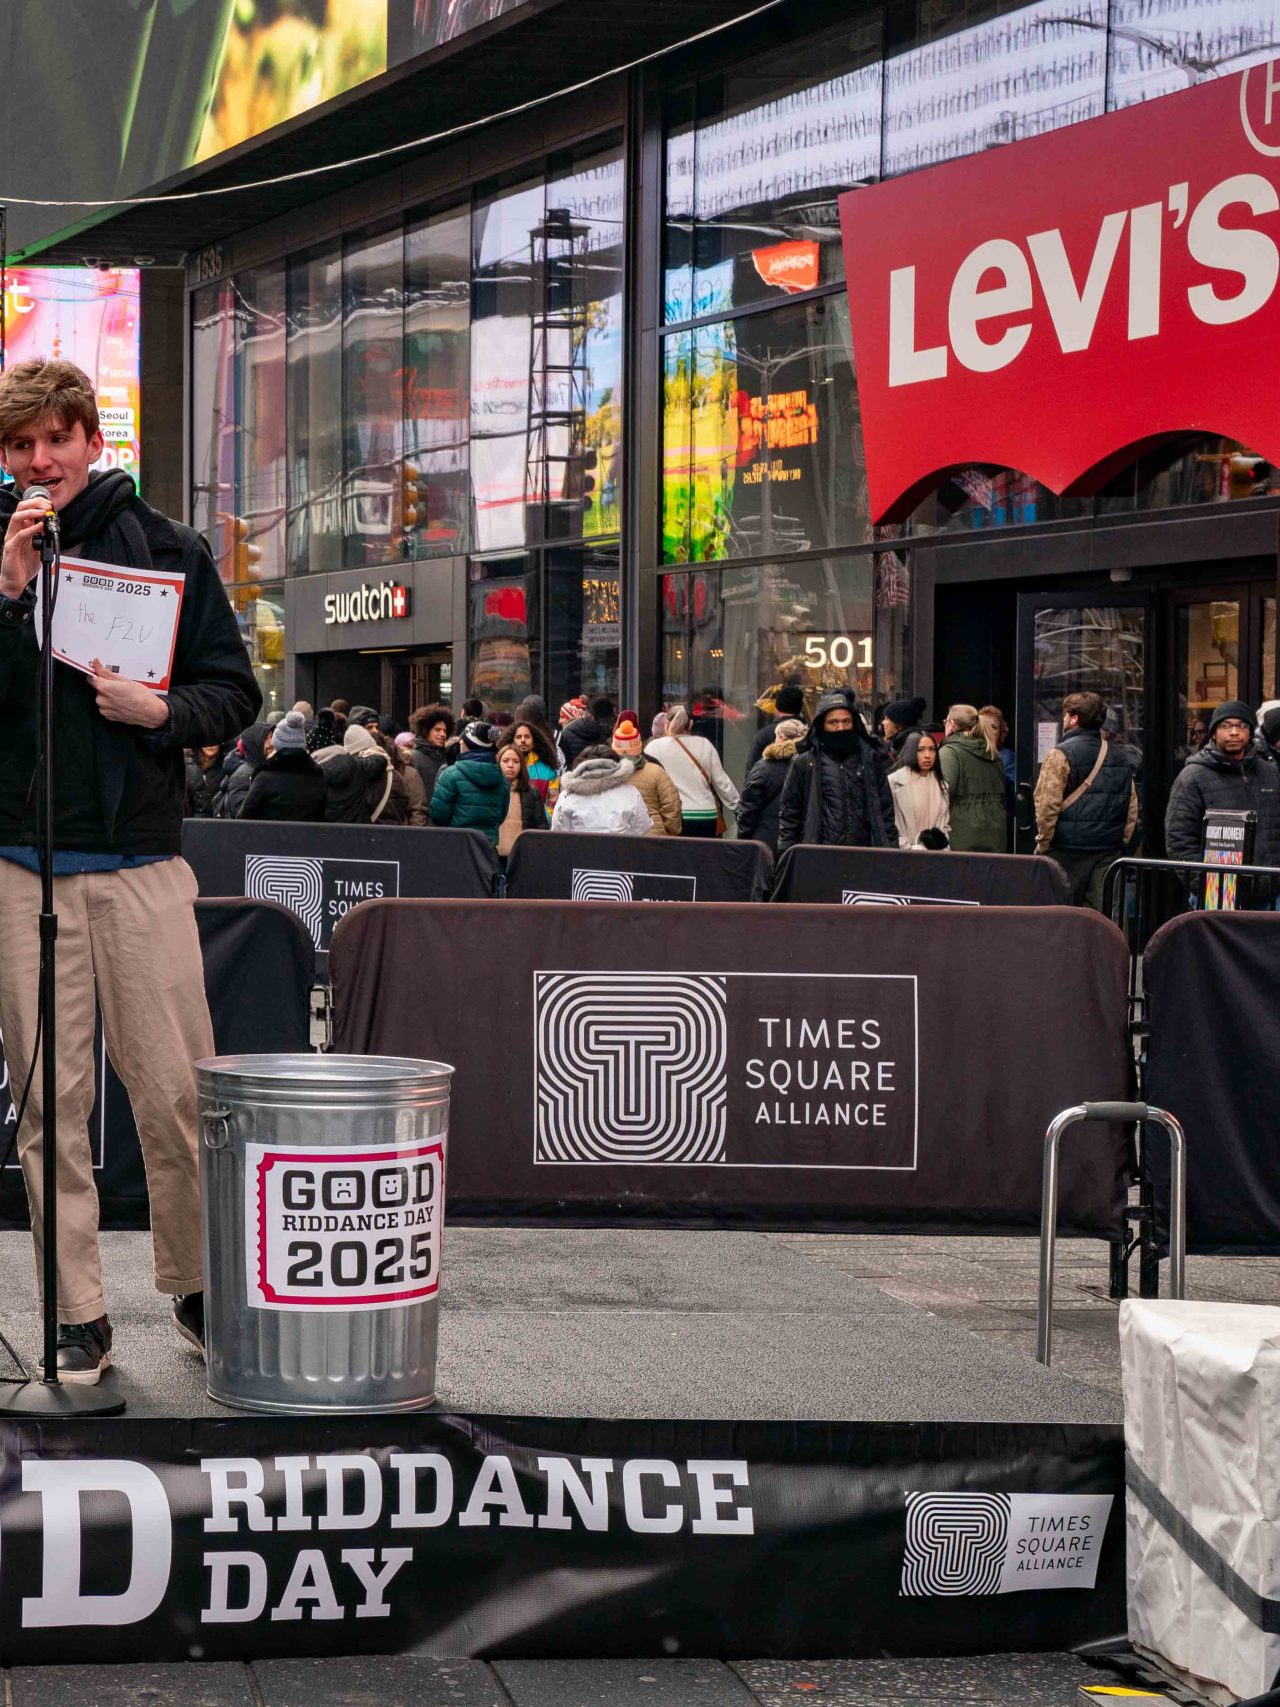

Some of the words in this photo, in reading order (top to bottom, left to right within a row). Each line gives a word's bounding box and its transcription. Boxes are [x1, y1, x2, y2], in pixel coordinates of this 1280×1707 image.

[99, 411, 129, 420] Seoul
[83, 575, 114, 587] GOOD
[116, 581, 151, 596] 2025
[77, 602, 96, 624] the
[324, 581, 393, 624] swatch
[804, 636, 873, 668] 501
[334, 880, 384, 898] TIMES
[759, 1017, 881, 1049] TIMES
[745, 1059, 895, 1094] SQUARE
[755, 1102, 887, 1126] ALLIANCE
[282, 1161, 434, 1211] GOOD
[282, 1212, 399, 1232] RIDDANCE
[404, 1205, 434, 1227] DAY
[287, 1232, 432, 1287] 2025
[201, 1453, 754, 1535] RIDDANCE
[1028, 1515, 1091, 1532] TIMES
[1016, 1536, 1094, 1555] SQUARE
[1016, 1557, 1084, 1571] ALLIANCE
[201, 1548, 412, 1622] DAY
